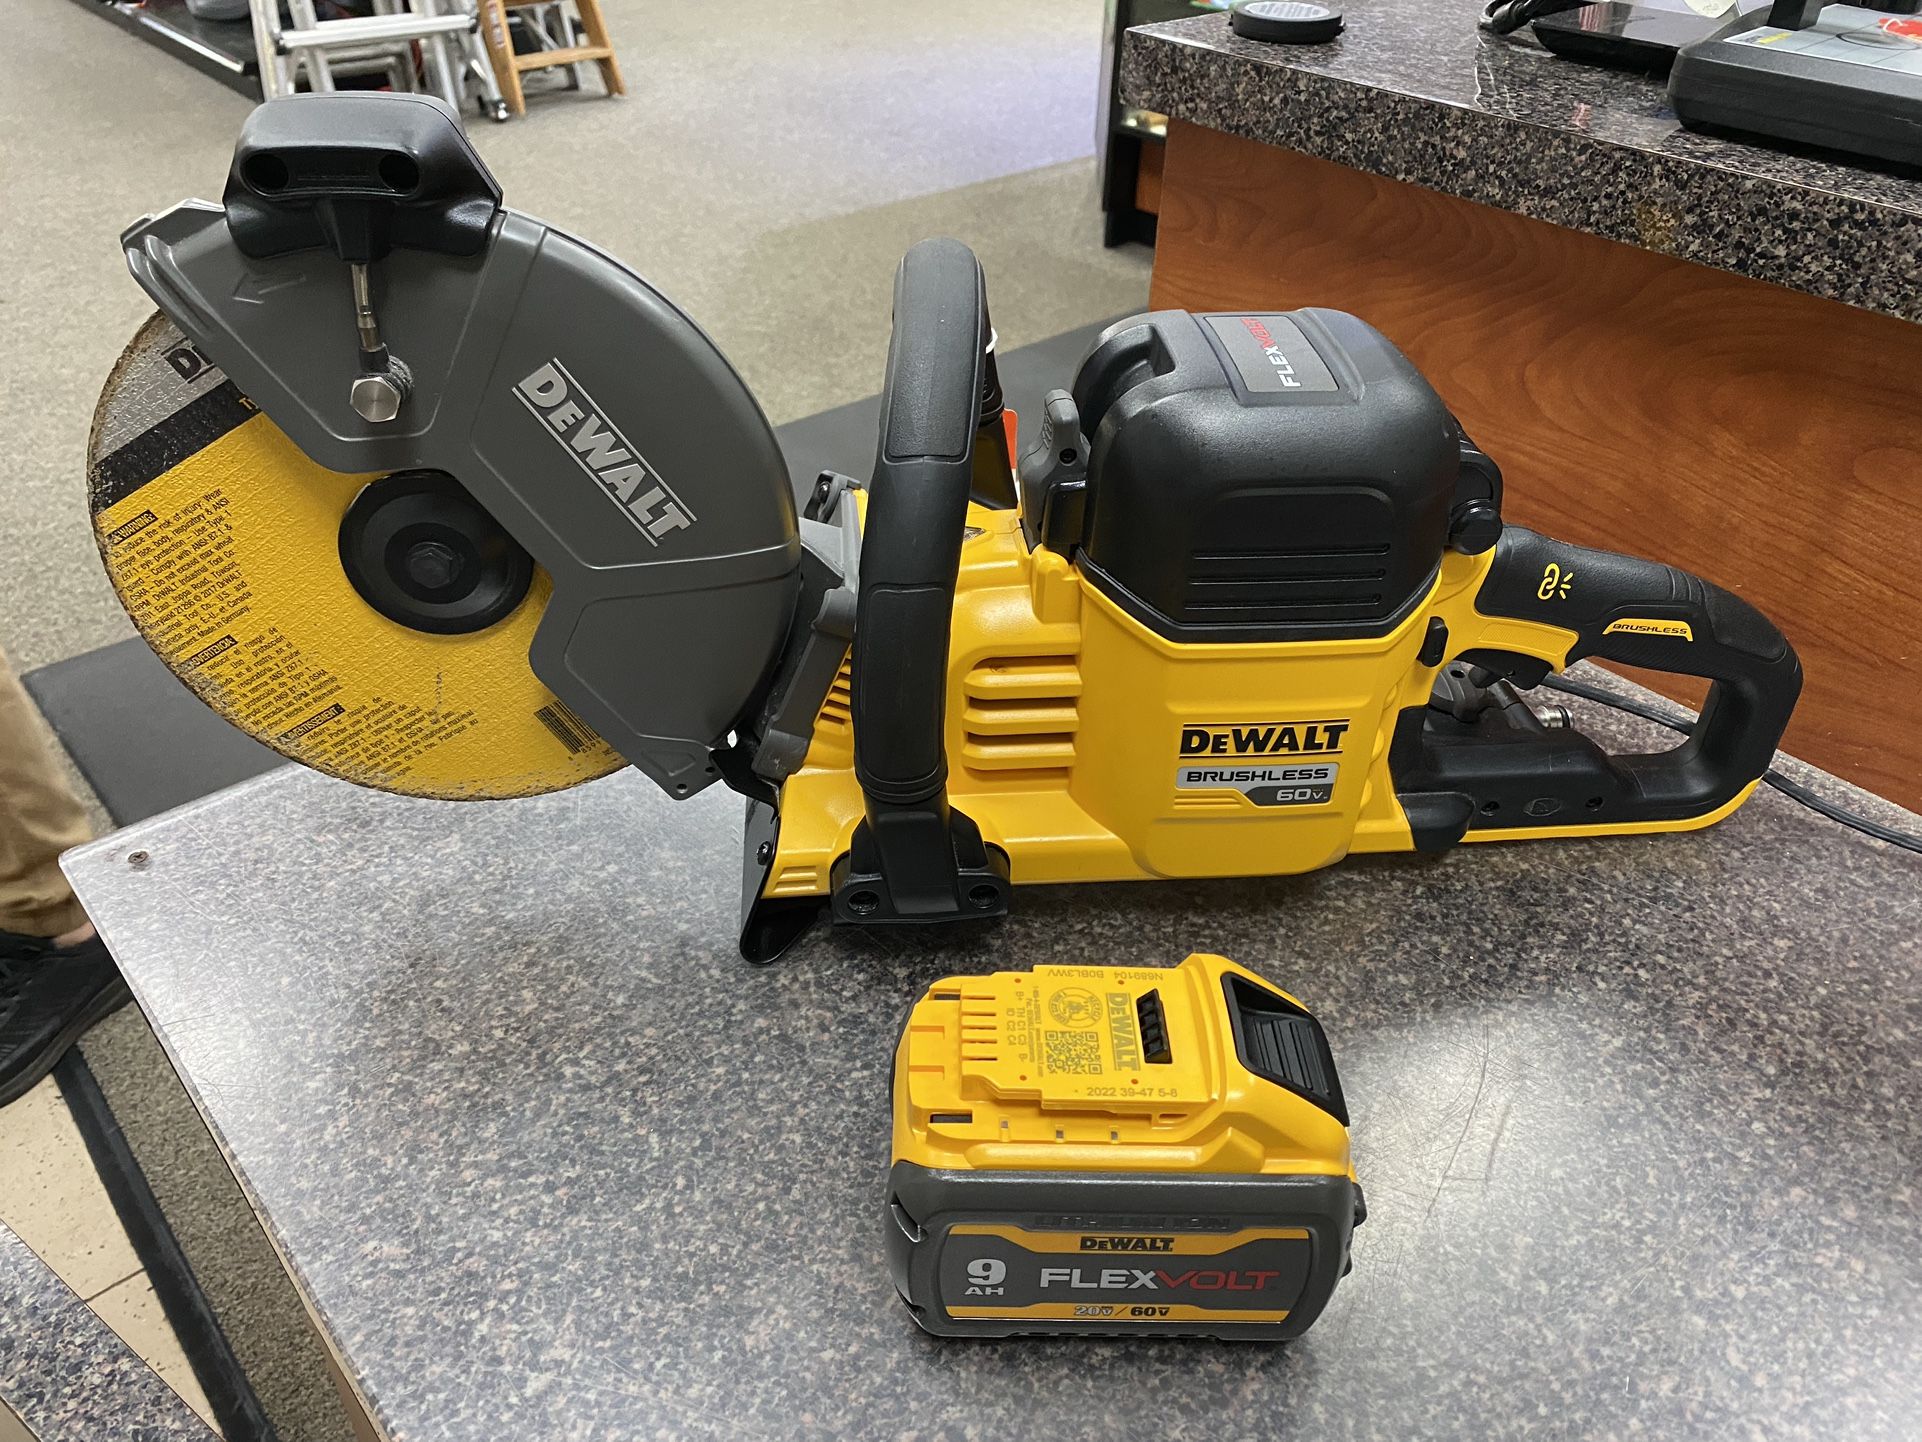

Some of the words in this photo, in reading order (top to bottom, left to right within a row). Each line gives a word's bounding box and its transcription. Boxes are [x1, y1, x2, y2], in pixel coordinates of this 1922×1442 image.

[1241, 318, 1301, 387] FLEXVOLT
[517, 361, 692, 541] DEWALT
[116, 509, 156, 539] WARNING:
[144, 526, 159, 539] the
[157, 518, 172, 531] risk
[171, 511, 182, 522] of
[201, 486, 223, 504] Wear
[114, 553, 138, 573] proper
[170, 510, 207, 538] respiratory
[203, 505, 213, 516] &
[211, 495, 231, 512] ANSI
[139, 557, 154, 571] eye
[152, 536, 187, 563] protection
[191, 522, 208, 538] Use
[205, 512, 226, 531] Type
[223, 508, 232, 518] 1
[150, 556, 177, 578] Comply
[174, 546, 192, 562] with
[190, 536, 208, 552] ANSI
[223, 521, 233, 532] &
[153, 576, 166, 588] Do
[163, 569, 177, 582] not
[175, 555, 200, 575] exceed
[197, 546, 214, 561] max
[212, 533, 235, 552] wheel
[177, 562, 209, 587] Industrial
[206, 552, 224, 569] Tool
[153, 599, 171, 614] East
[169, 586, 193, 605] Joppa
[183, 608, 200, 622] Tool
[232, 578, 248, 592] and
[200, 584, 217, 599] 2017
[217, 604, 228, 614] et
[225, 587, 253, 610] Canada
[214, 619, 224, 629] in
[1613, 624, 1687, 634] BRUSHLESS
[205, 653, 231, 672] reducir
[231, 646, 242, 657] el
[242, 632, 266, 651] riesgo
[266, 624, 279, 636] de
[234, 669, 245, 680] en
[243, 663, 253, 674] el
[284, 639, 294, 650] el
[229, 656, 245, 670] Uso
[235, 663, 274, 691] respiratoria
[278, 646, 302, 665] ocular
[267, 667, 286, 683] ANSI
[260, 698, 274, 711] con
[272, 689, 290, 704] ANSI
[307, 666, 329, 684] OSHA
[276, 678, 288, 690] de
[288, 668, 305, 683] Tipo
[370, 693, 382, 705] de
[250, 716, 263, 728] No
[1180, 723, 1349, 755] DEWALT
[1187, 768, 1329, 782] BRUSHLESS
[1109, 993, 1138, 1071] DEWALT
[1087, 1087, 1117, 1097] 2022
[1120, 1087, 1153, 1098] 39-47
[1159, 1088, 1178, 1098] 5-8
[1080, 1236, 1174, 1251] DEWALT
[967, 1258, 1007, 1286] 9
[1040, 1267, 1280, 1290] FLEXVOLT
[964, 1286, 1004, 1296] AH
